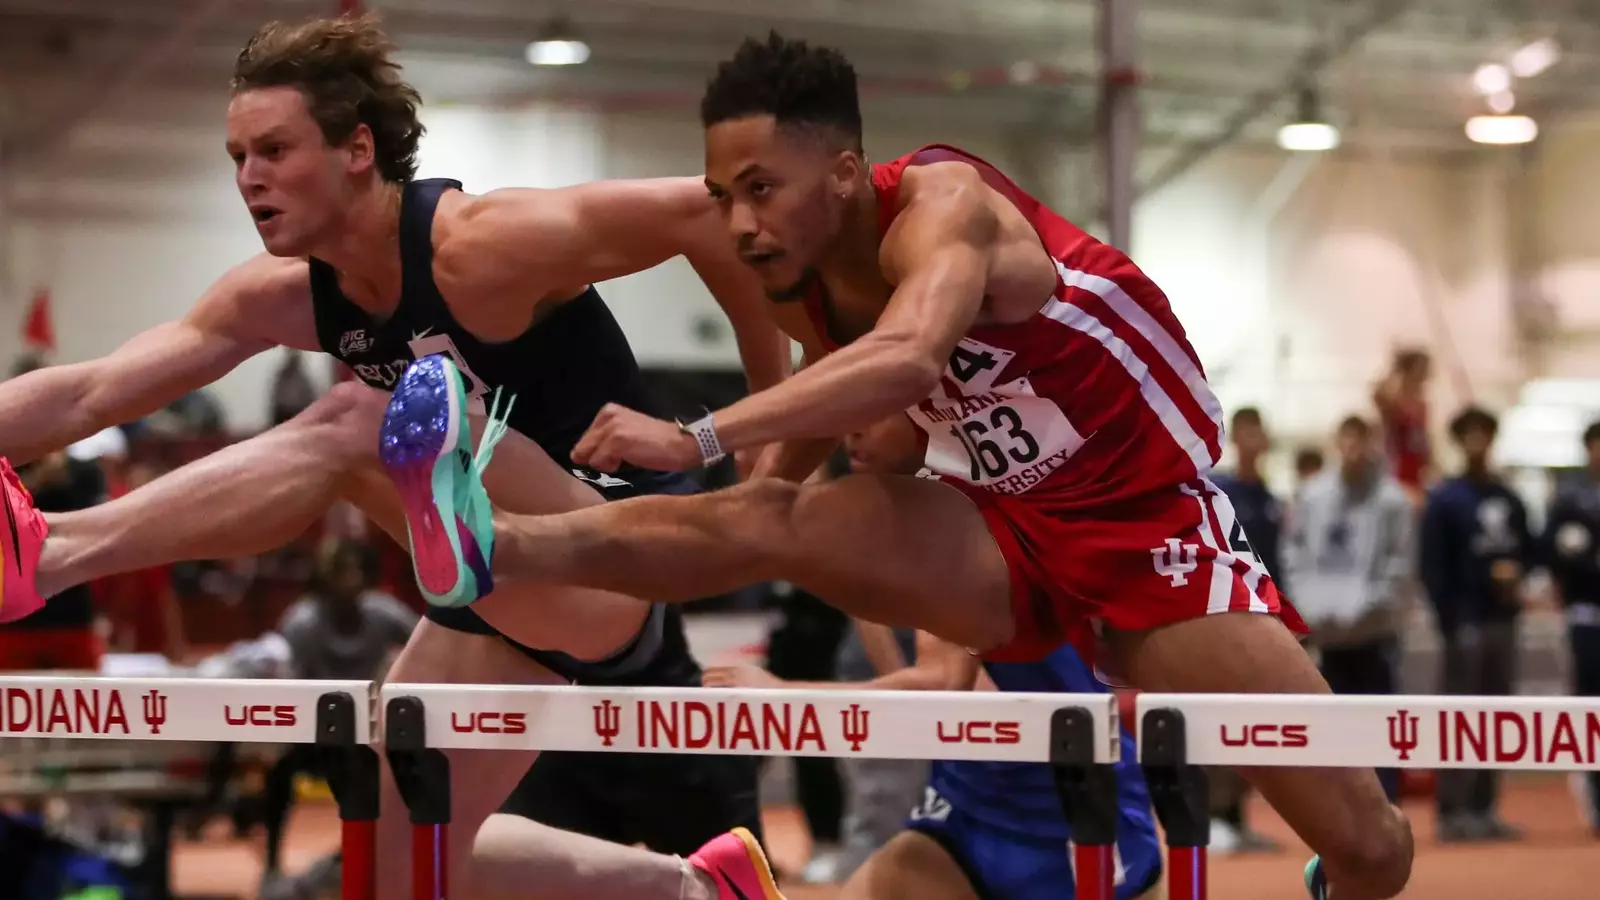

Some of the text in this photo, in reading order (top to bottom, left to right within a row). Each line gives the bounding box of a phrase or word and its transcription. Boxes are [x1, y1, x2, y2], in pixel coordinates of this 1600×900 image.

[949, 345, 1000, 384] 4
[950, 406, 1040, 481] 163
[0, 687, 131, 734] DIANA
[225, 704, 298, 727] UCS
[451, 711, 528, 734] UCS
[636, 700, 826, 751] INDIANA
[937, 720, 1021, 744] UCS
[1220, 724, 1311, 748] UCS
